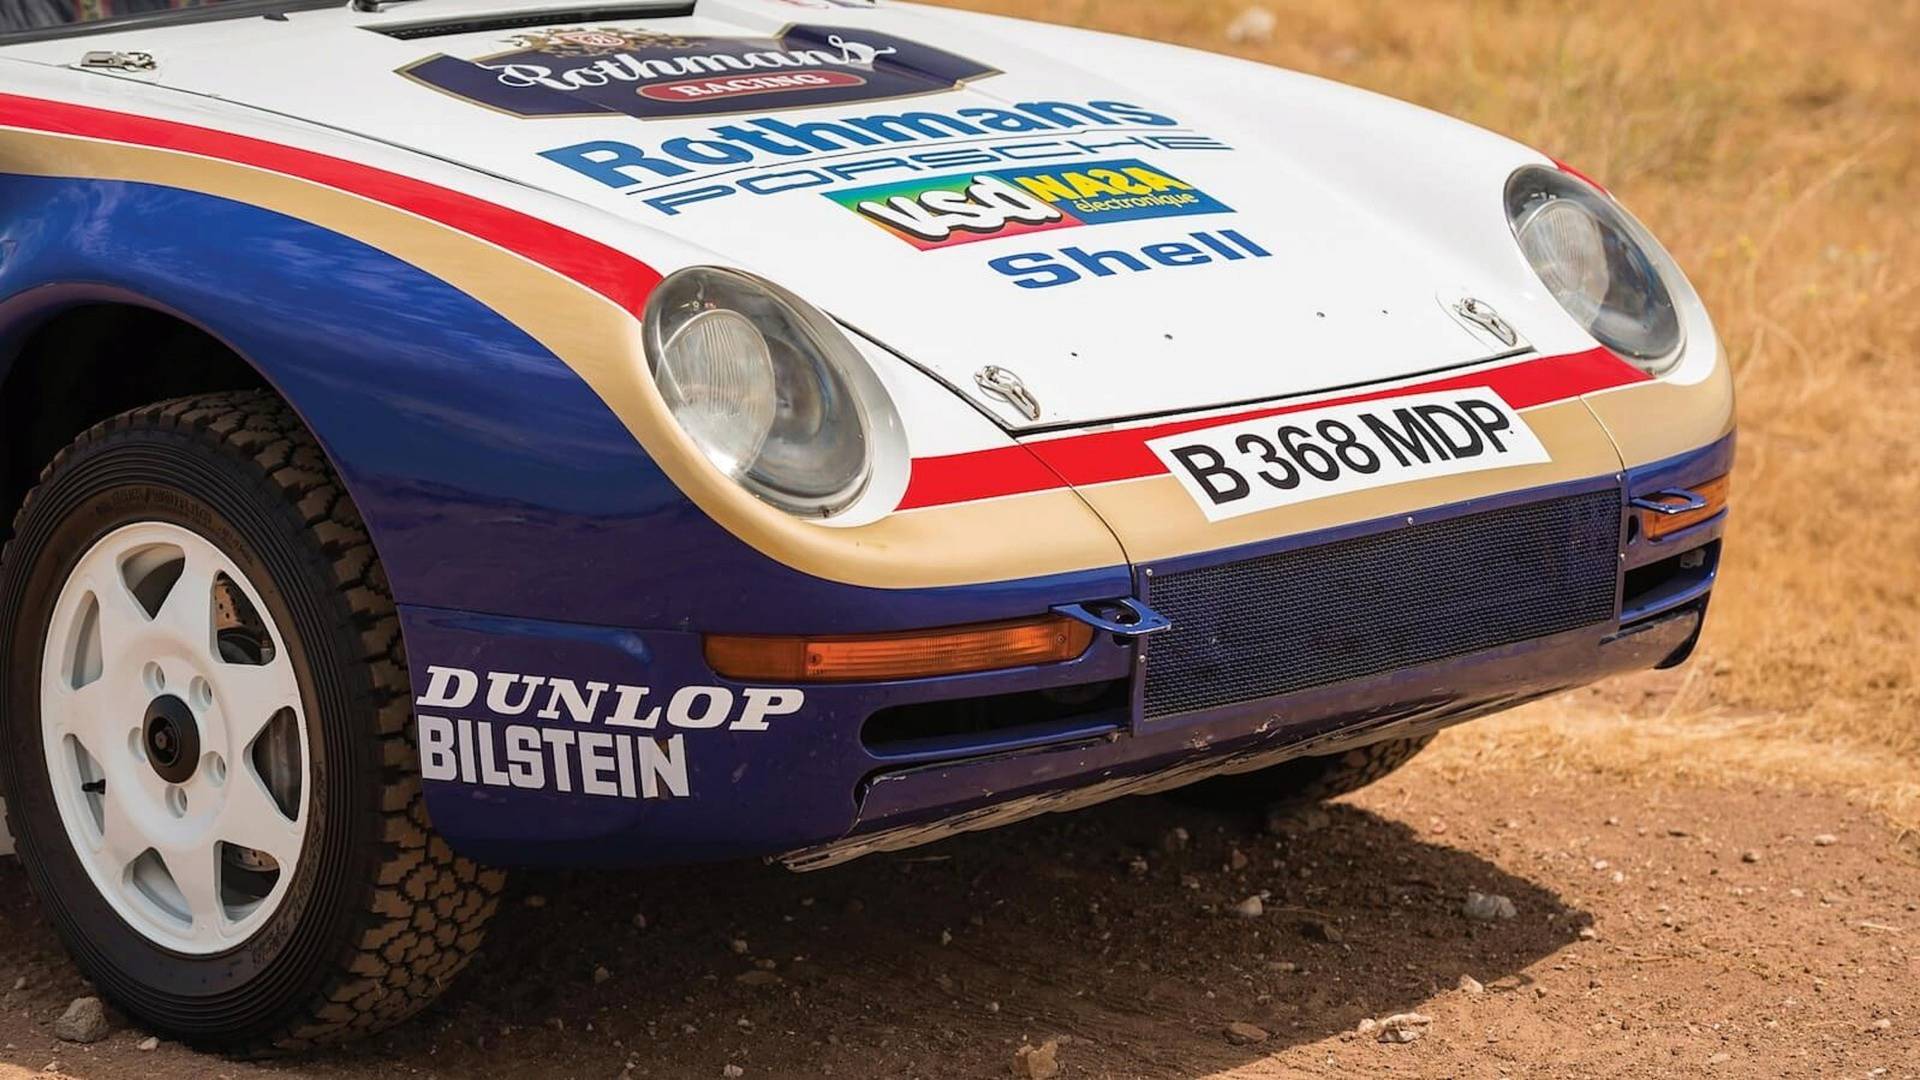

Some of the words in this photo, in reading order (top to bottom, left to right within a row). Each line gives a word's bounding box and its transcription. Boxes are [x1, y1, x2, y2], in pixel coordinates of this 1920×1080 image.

[479, 35, 896, 91] Rothmans
[670, 74, 832, 98] RACING
[537, 99, 1178, 188] Rothmans
[642, 135, 1234, 215] PORSCHE
[1075, 191, 1199, 213] électronique
[988, 229, 1272, 289] Shell
[1170, 444, 1250, 504] B
[1235, 418, 1381, 490] 368
[1357, 399, 1511, 464] MDP
[416, 665, 805, 731] DUNLOP
[417, 714, 691, 799] BILSTEIN
